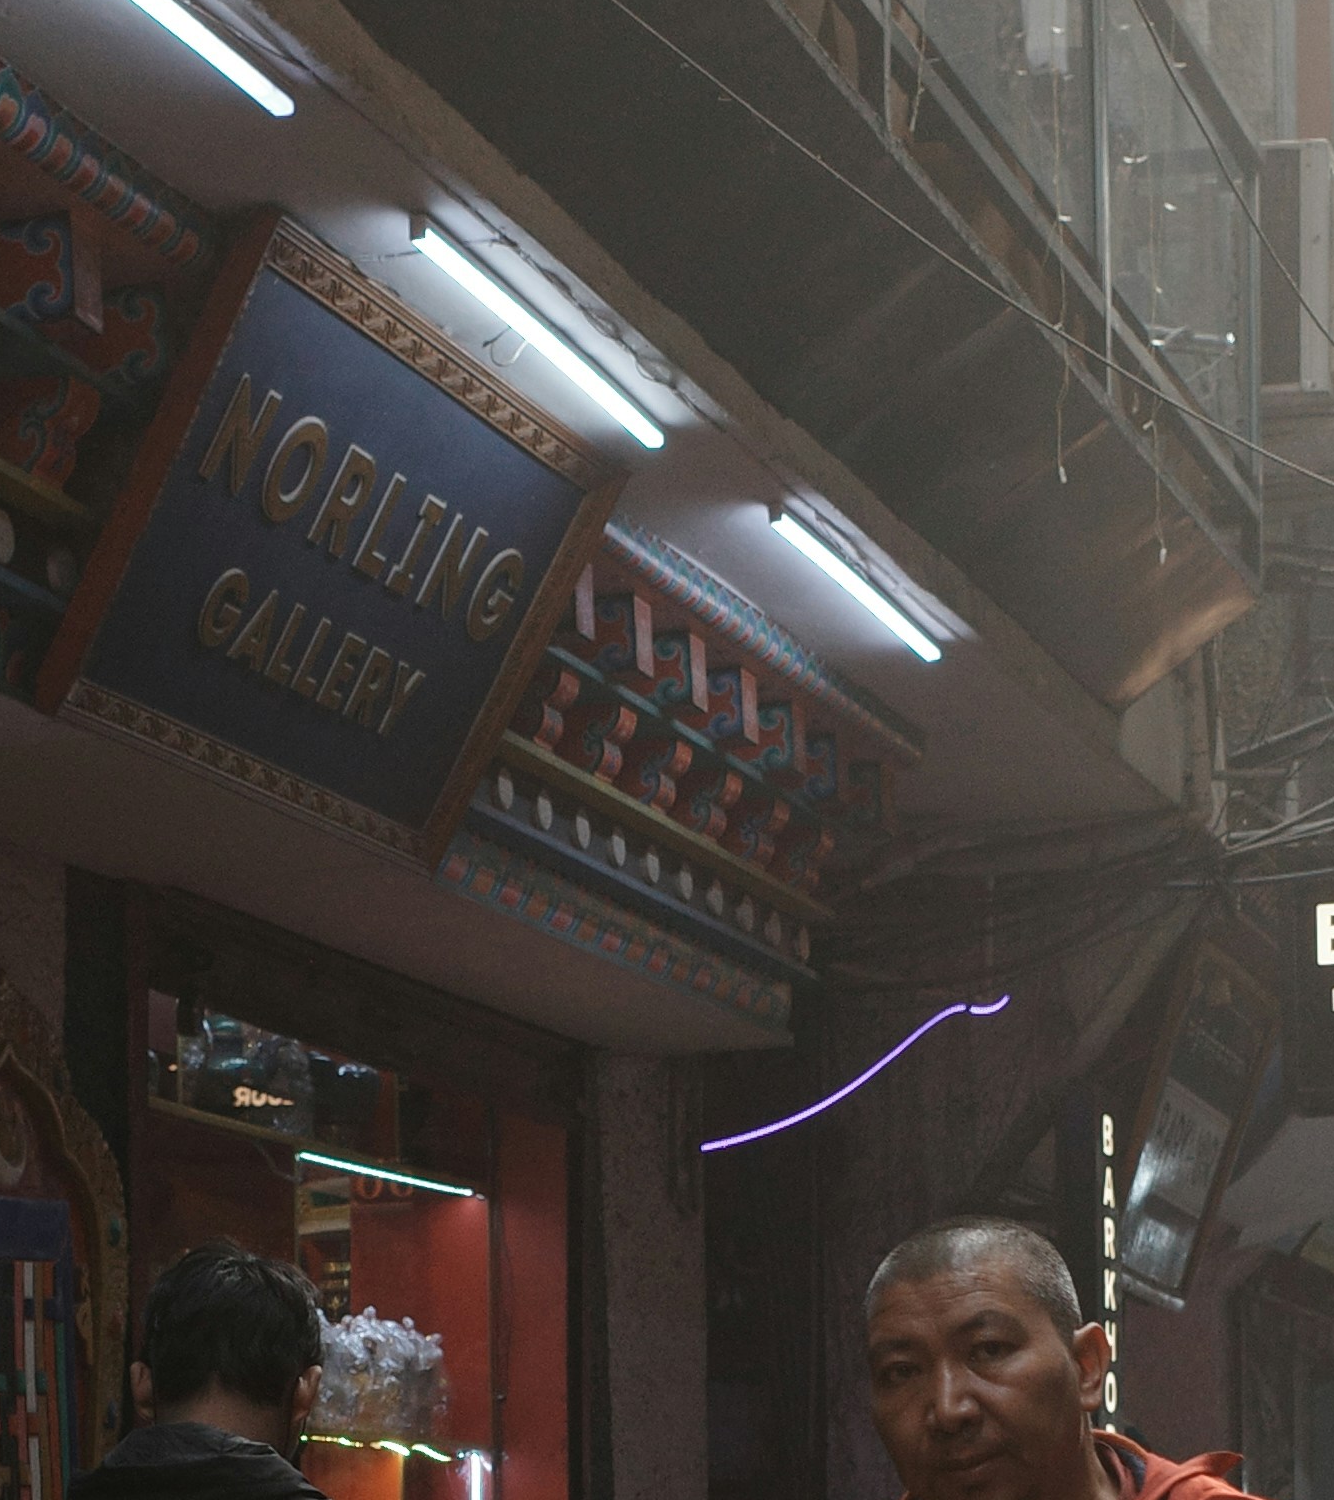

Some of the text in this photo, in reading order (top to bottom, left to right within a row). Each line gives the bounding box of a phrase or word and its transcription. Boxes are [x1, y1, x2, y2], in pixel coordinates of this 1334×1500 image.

[198, 372, 525, 641] NORLING
[197, 567, 427, 736] GALLERY
[1101, 1112, 1117, 1434] BARKHO
